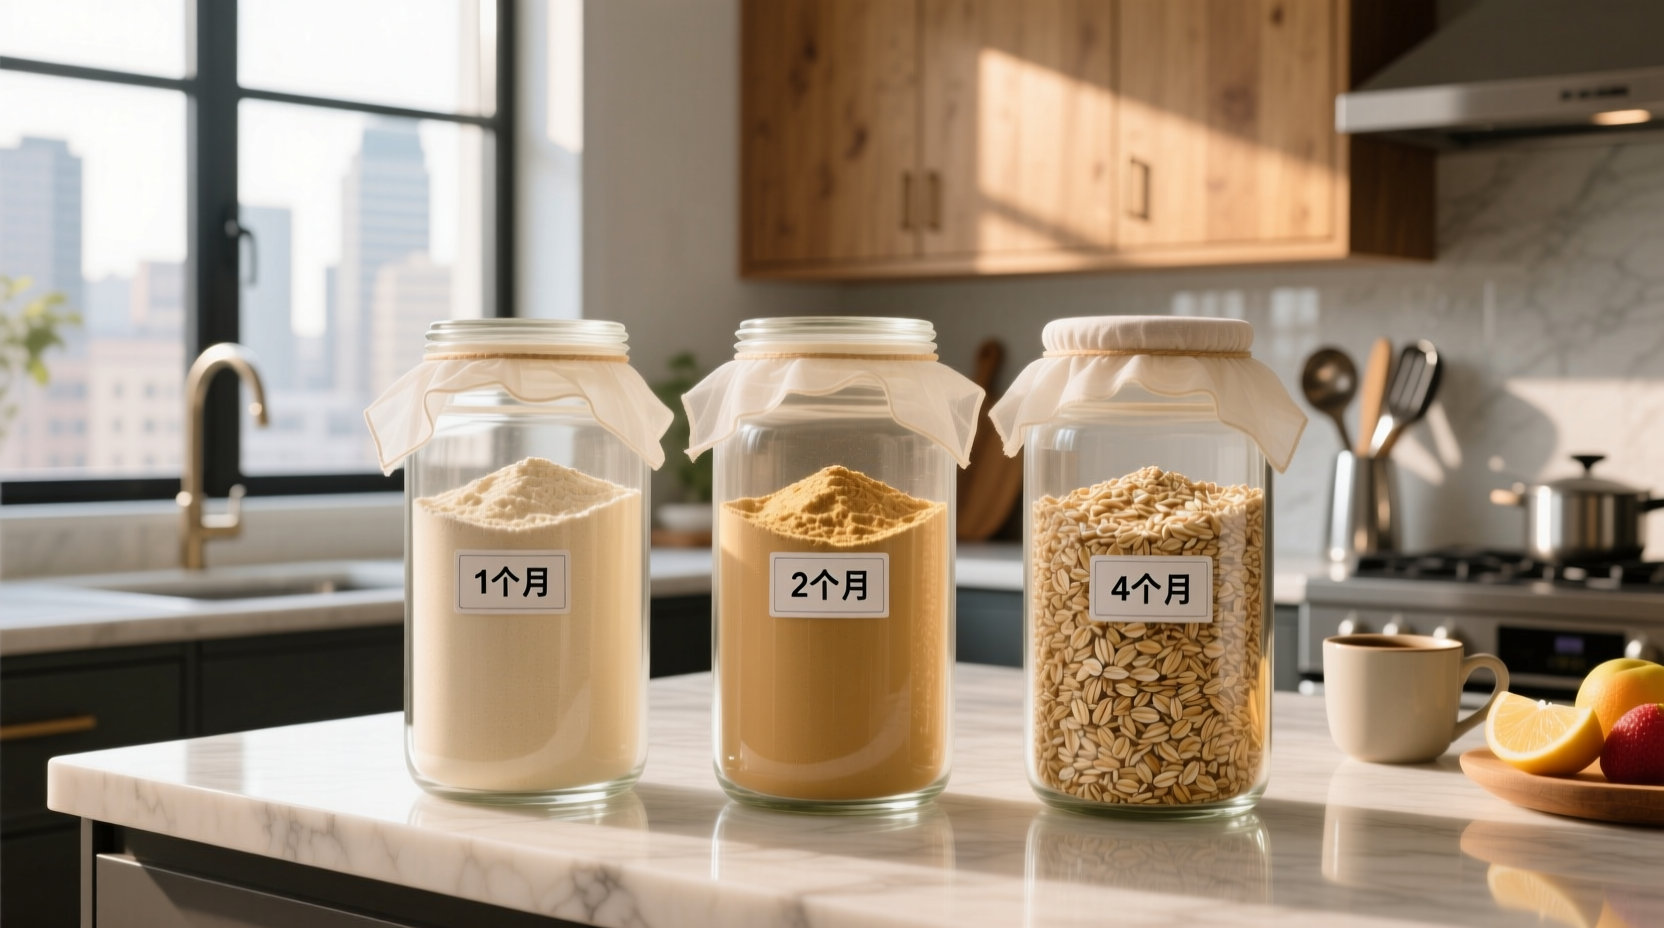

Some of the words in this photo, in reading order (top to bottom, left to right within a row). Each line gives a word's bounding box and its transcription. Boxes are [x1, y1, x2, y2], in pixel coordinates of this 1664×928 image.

[474, 565, 549, 598] 1个月
[790, 568, 868, 602] 2个月
[1110, 572, 1190, 606] 4个月
